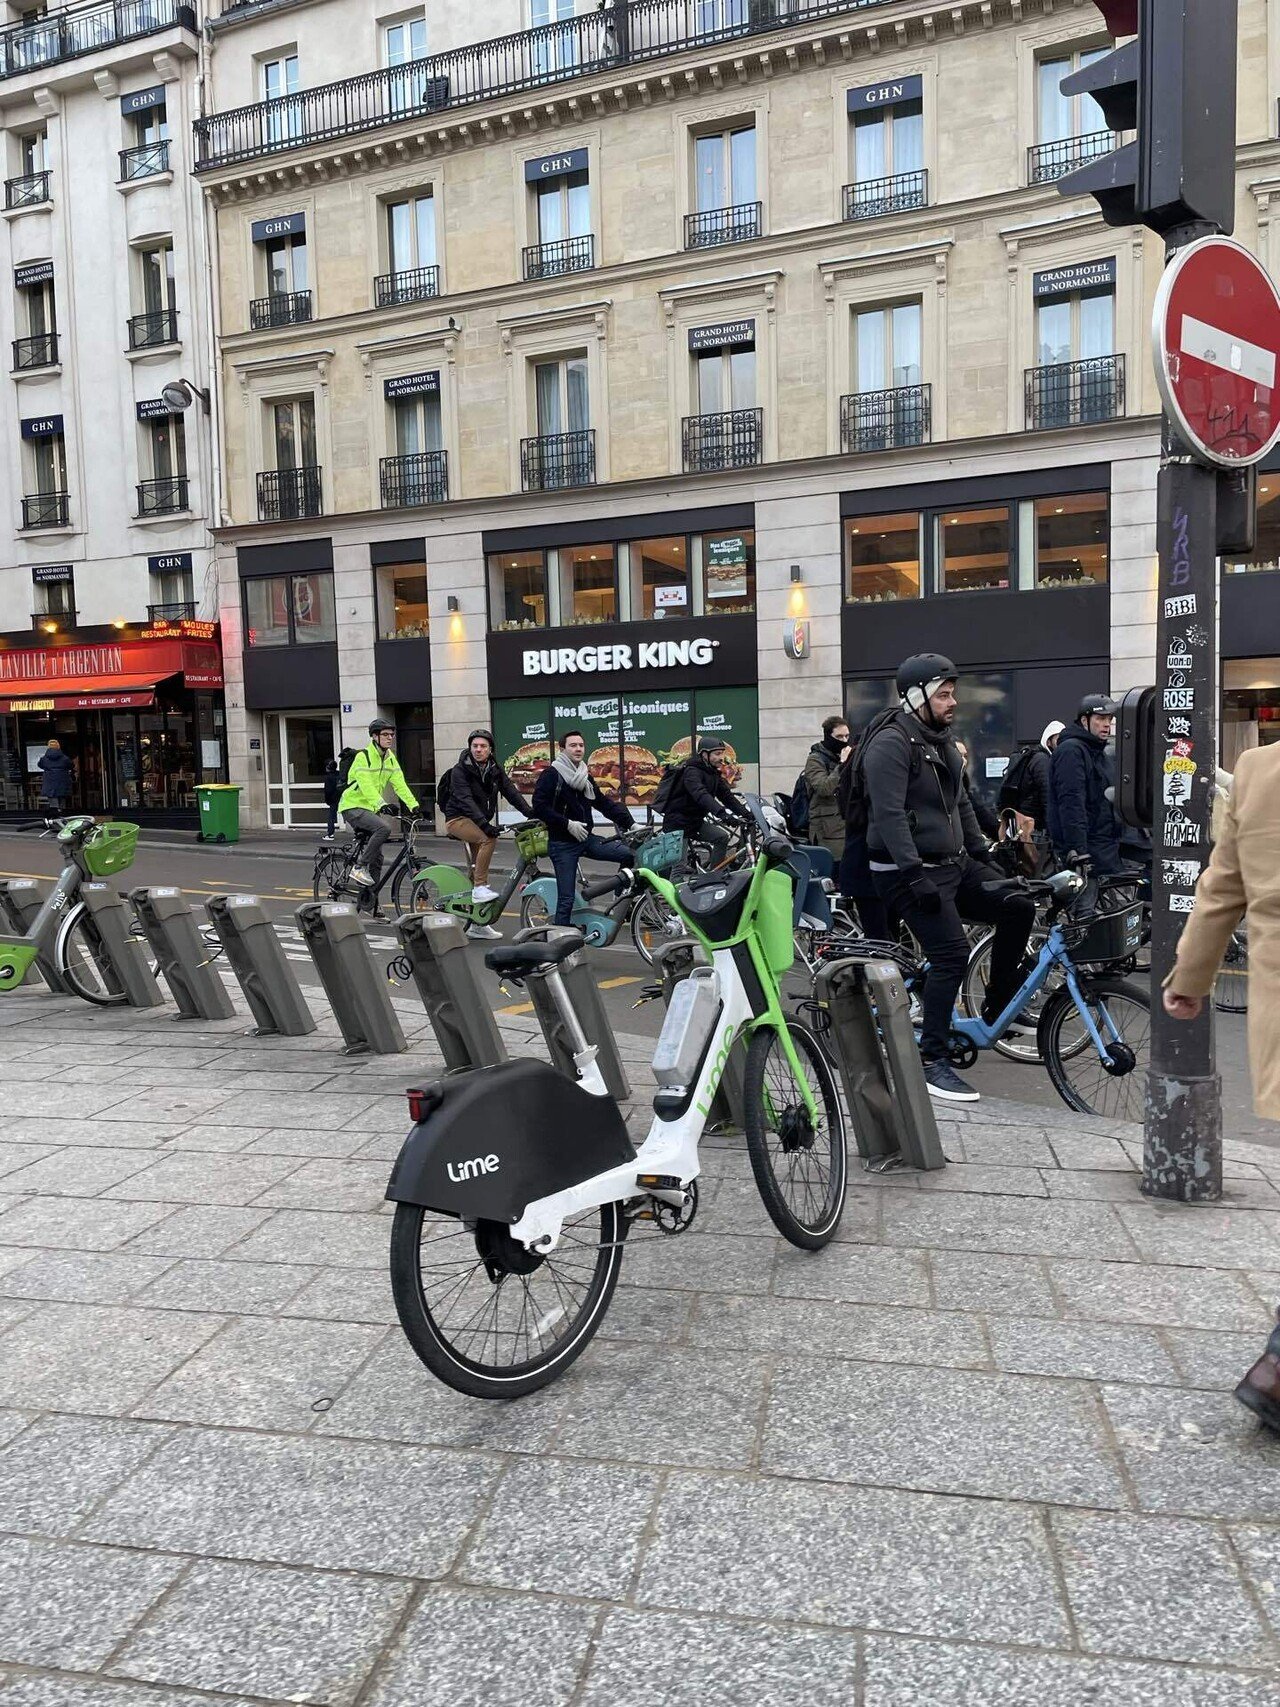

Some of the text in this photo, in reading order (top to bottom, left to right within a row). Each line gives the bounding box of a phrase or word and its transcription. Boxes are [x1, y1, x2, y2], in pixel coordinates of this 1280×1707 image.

[131, 93, 156, 108] GHN
[865, 84, 904, 103] GHN
[540, 156, 572, 173] GHN
[265, 220, 292, 234] GHN
[17, 264, 52, 277] GRAND HOTEL
[23, 272, 53, 283] NORMANDIE
[1040, 263, 1109, 282] GRAND HOTEL
[1039, 273, 1111, 293] DE NORMANDIE
[694, 323, 750, 338] GRAND HOTEL
[388, 374, 435, 388] GRAND HOTEL
[396, 383, 436, 395] NORMANDIE
[141, 401, 160, 410] GRAND
[32, 421, 54, 432] GHN
[158, 557, 182, 568] GHN
[153, 621, 167, 629] BAR
[183, 621, 215, 632] MOULES
[141, 629, 182, 638] RESTAURANT
[187, 629, 213, 638] FRITES
[523, 638, 714, 676] BURGER KING
[1163, 690, 1194, 708] ROSE
[554, 706, 576, 718] Nos
[585, 701, 619, 715] Veggie
[629, 700, 690, 716] iconiques
[447, 1154, 500, 1182] Lime
